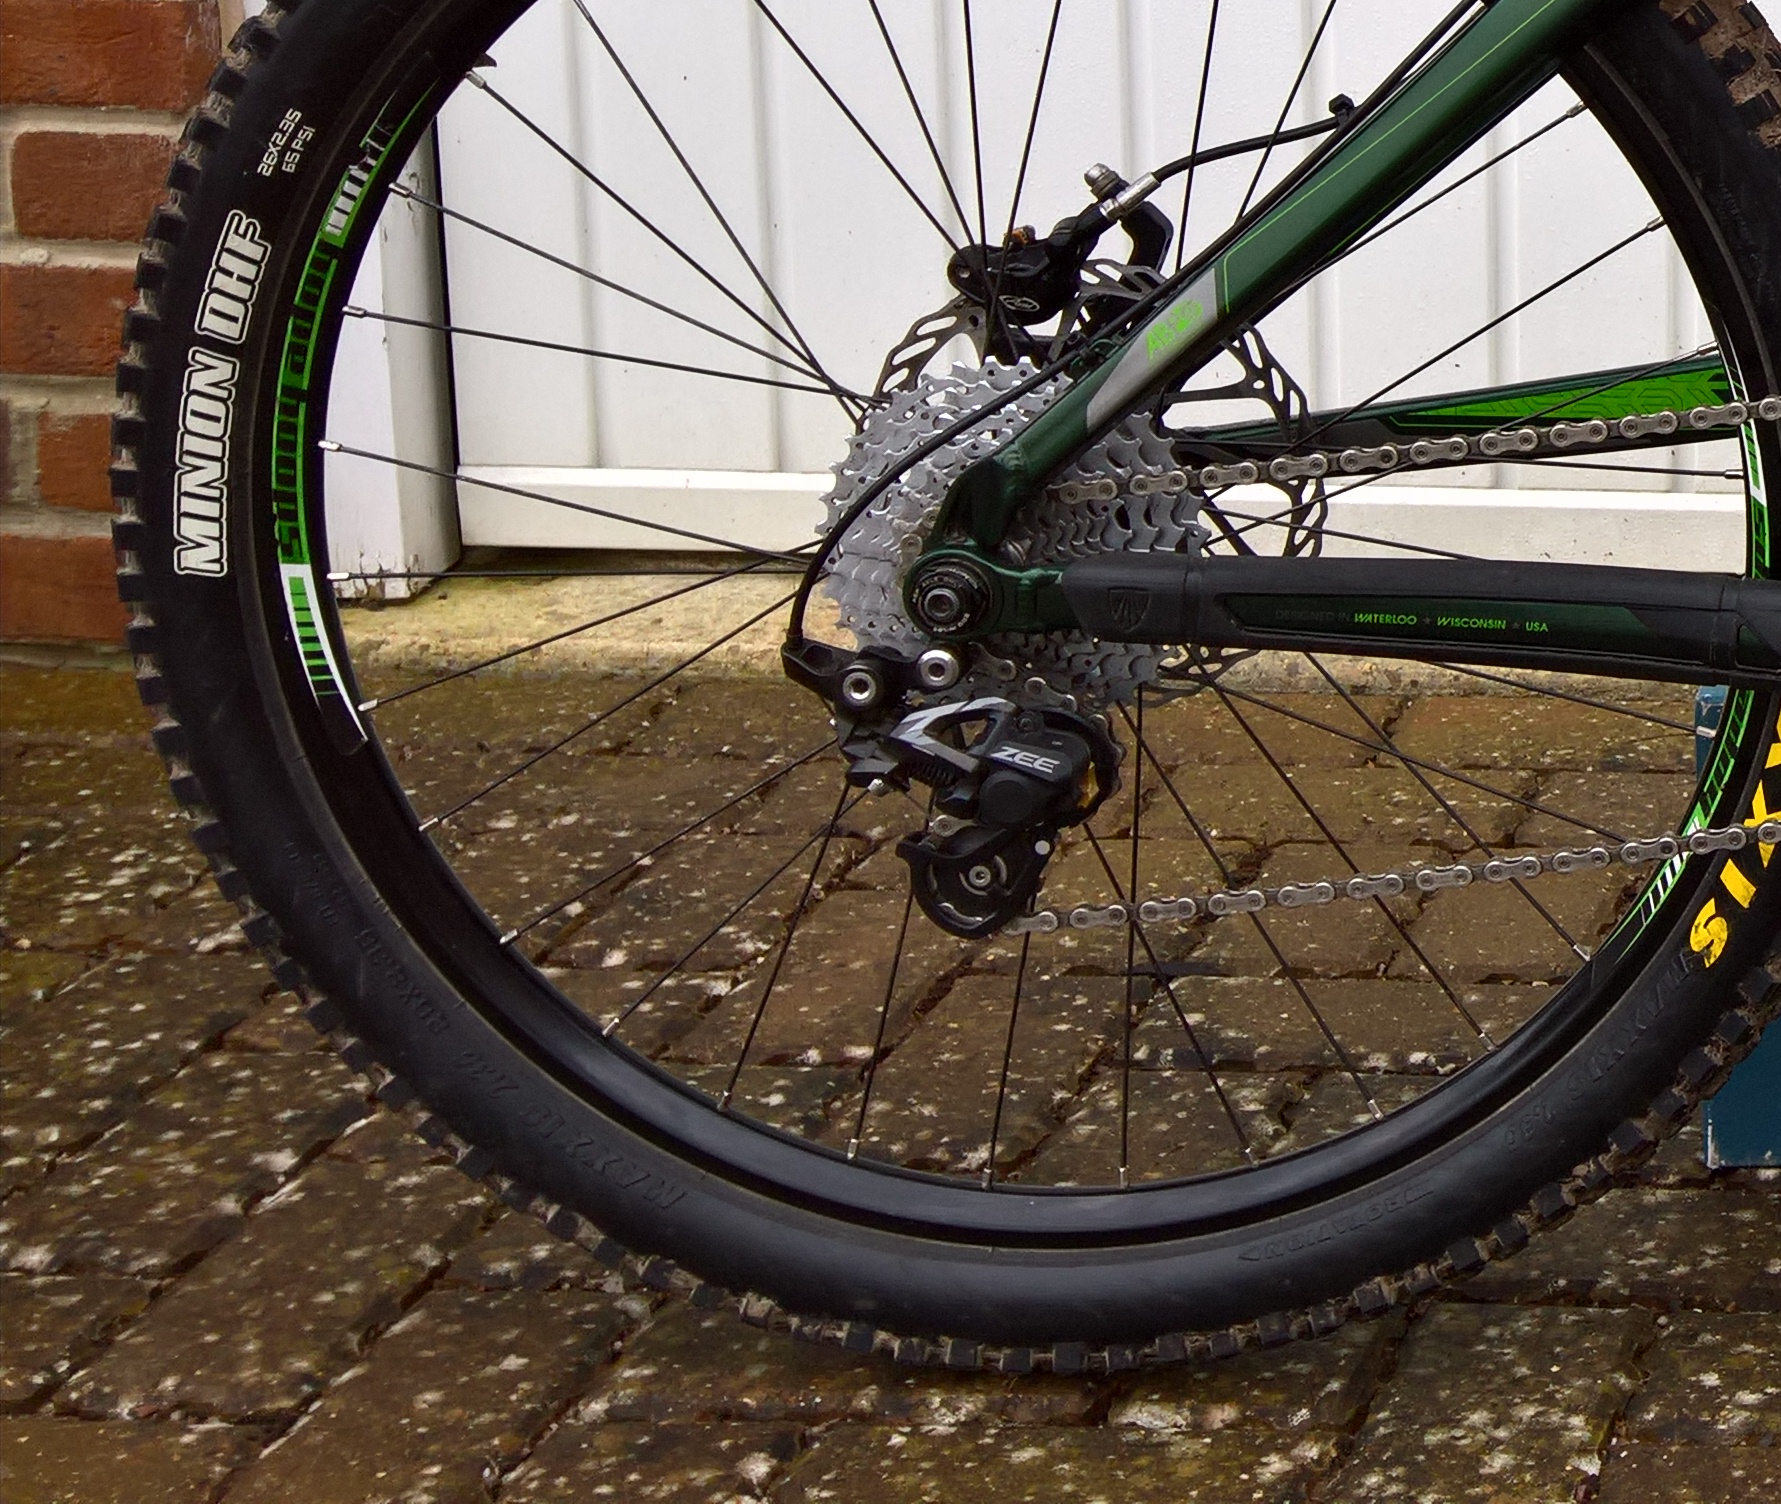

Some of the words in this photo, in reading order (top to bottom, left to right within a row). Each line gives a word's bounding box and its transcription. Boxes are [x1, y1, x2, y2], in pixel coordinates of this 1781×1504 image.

[257, 107, 303, 177] 26X2.35
[281, 150, 299, 174] 65
[292, 125, 317, 152] PSI
[195, 209, 272, 345] DHF
[173, 346, 238, 577] MINION
[1354, 612, 1418, 626] WATERLOO
[1436, 615, 1508, 630] WISCONSIN
[1525, 621, 1550, 633] USA
[990, 746, 1061, 774] ZEE
